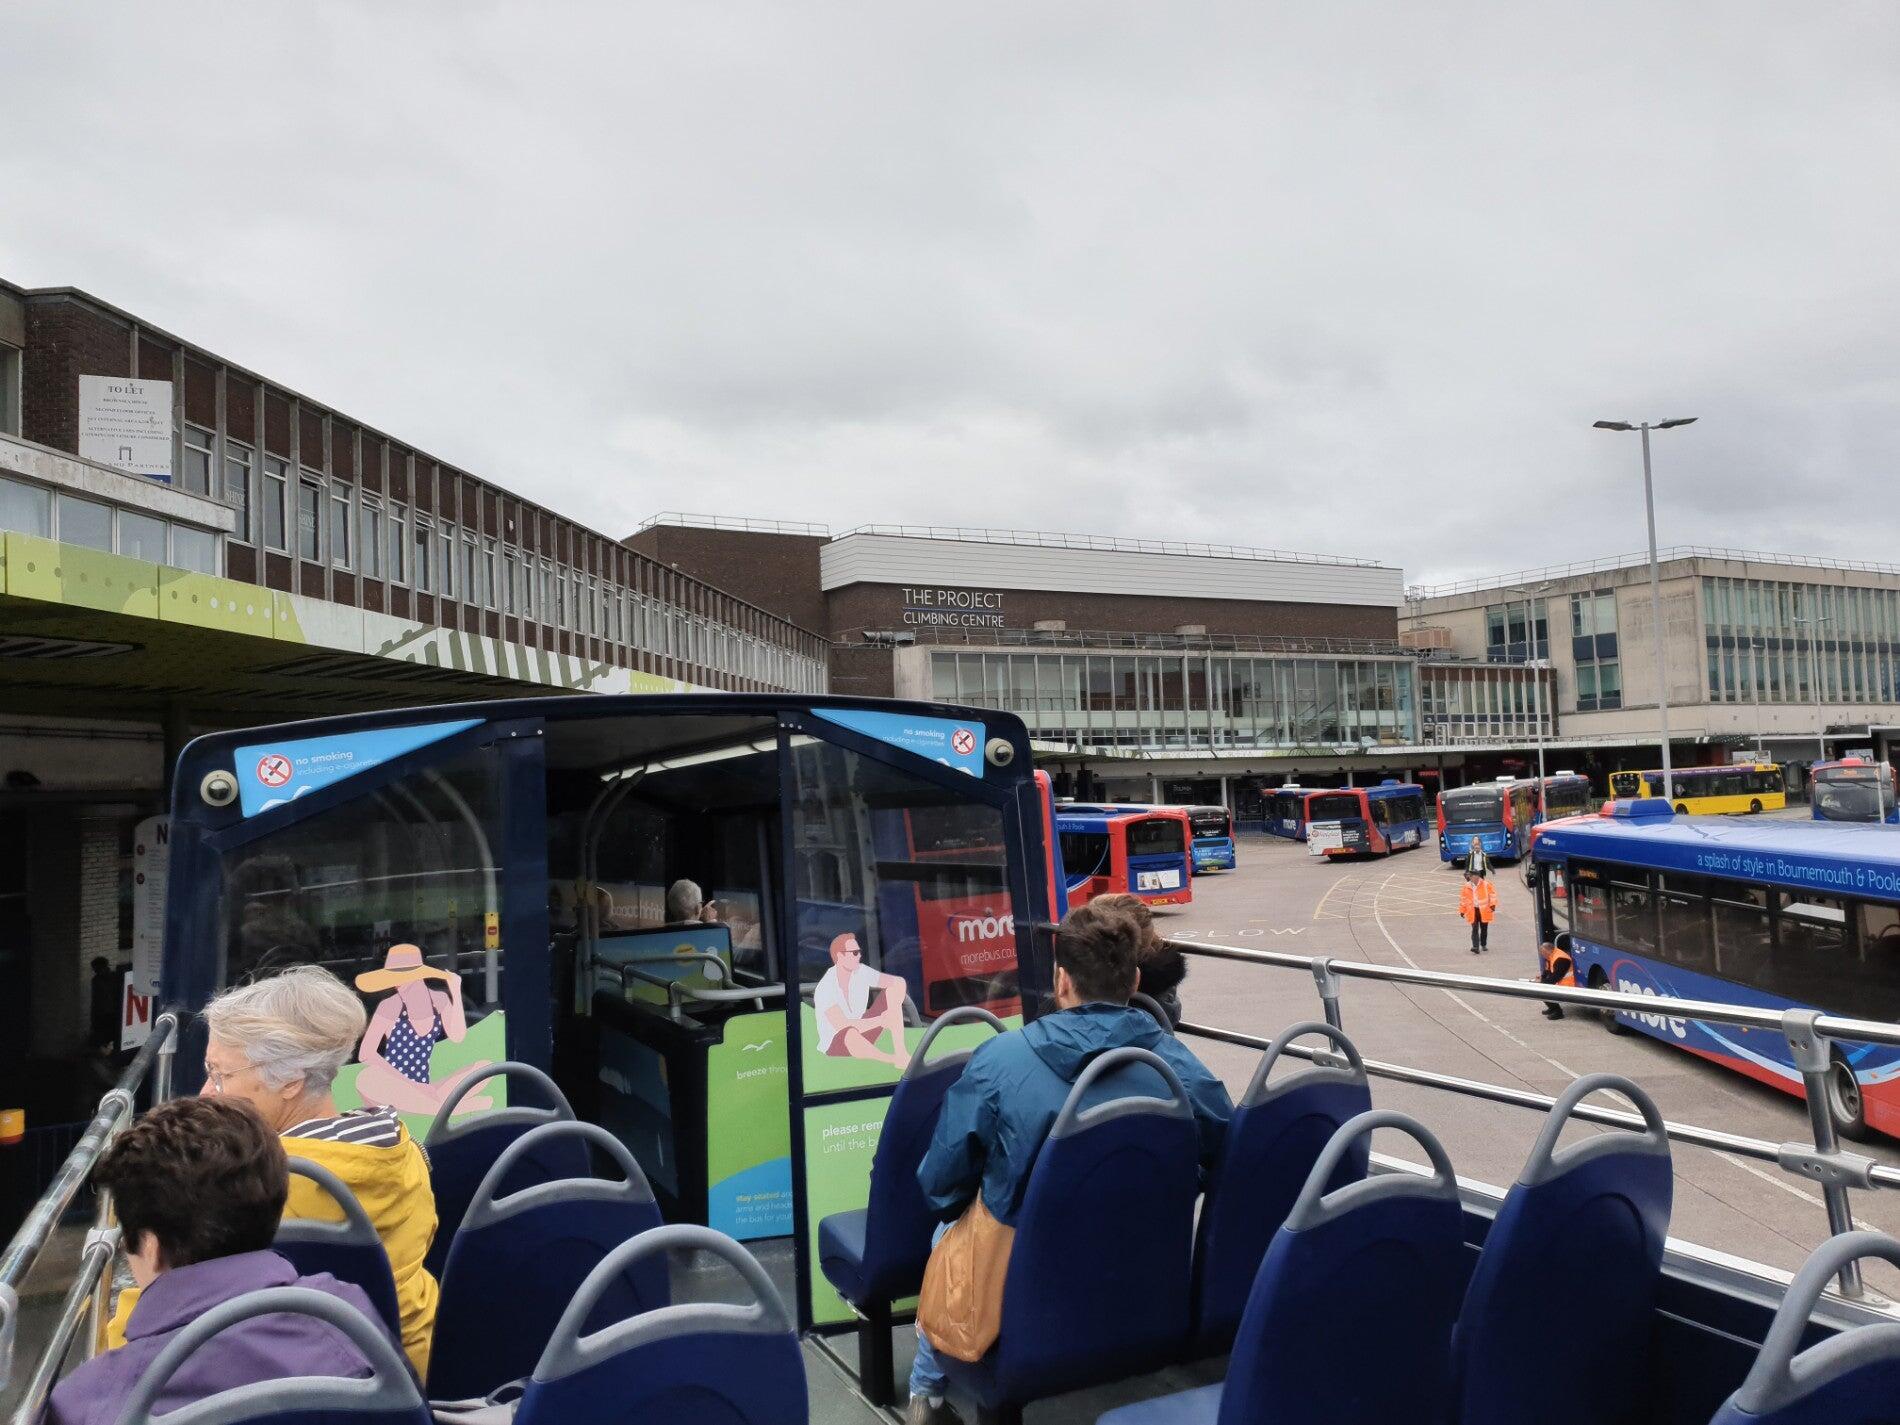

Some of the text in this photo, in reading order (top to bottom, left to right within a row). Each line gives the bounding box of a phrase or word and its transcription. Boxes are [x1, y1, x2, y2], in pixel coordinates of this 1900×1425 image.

[108, 385, 144, 395] TO LET
[902, 588, 1004, 609] THE PROJECT
[903, 612, 1005, 628] CLIMBING CENTRE
[914, 729, 945, 740] smoking
[295, 751, 354, 766] no smoking
[156, 823, 169, 845] N
[1697, 854, 1703, 866] a
[1704, 852, 1731, 872] splash
[1732, 855, 1741, 872] of
[1743, 857, 1764, 877] style
[1766, 859, 1776, 876] in
[1777, 858, 1854, 886] Bournemouth
[1856, 868, 1865, 887] &
[1171, 927, 1307, 939] SLOW
[736, 1067, 767, 1080] breeze
[822, 1123, 859, 1141] please
[823, 1139, 846, 1154] until
[848, 1138, 866, 1150] the
